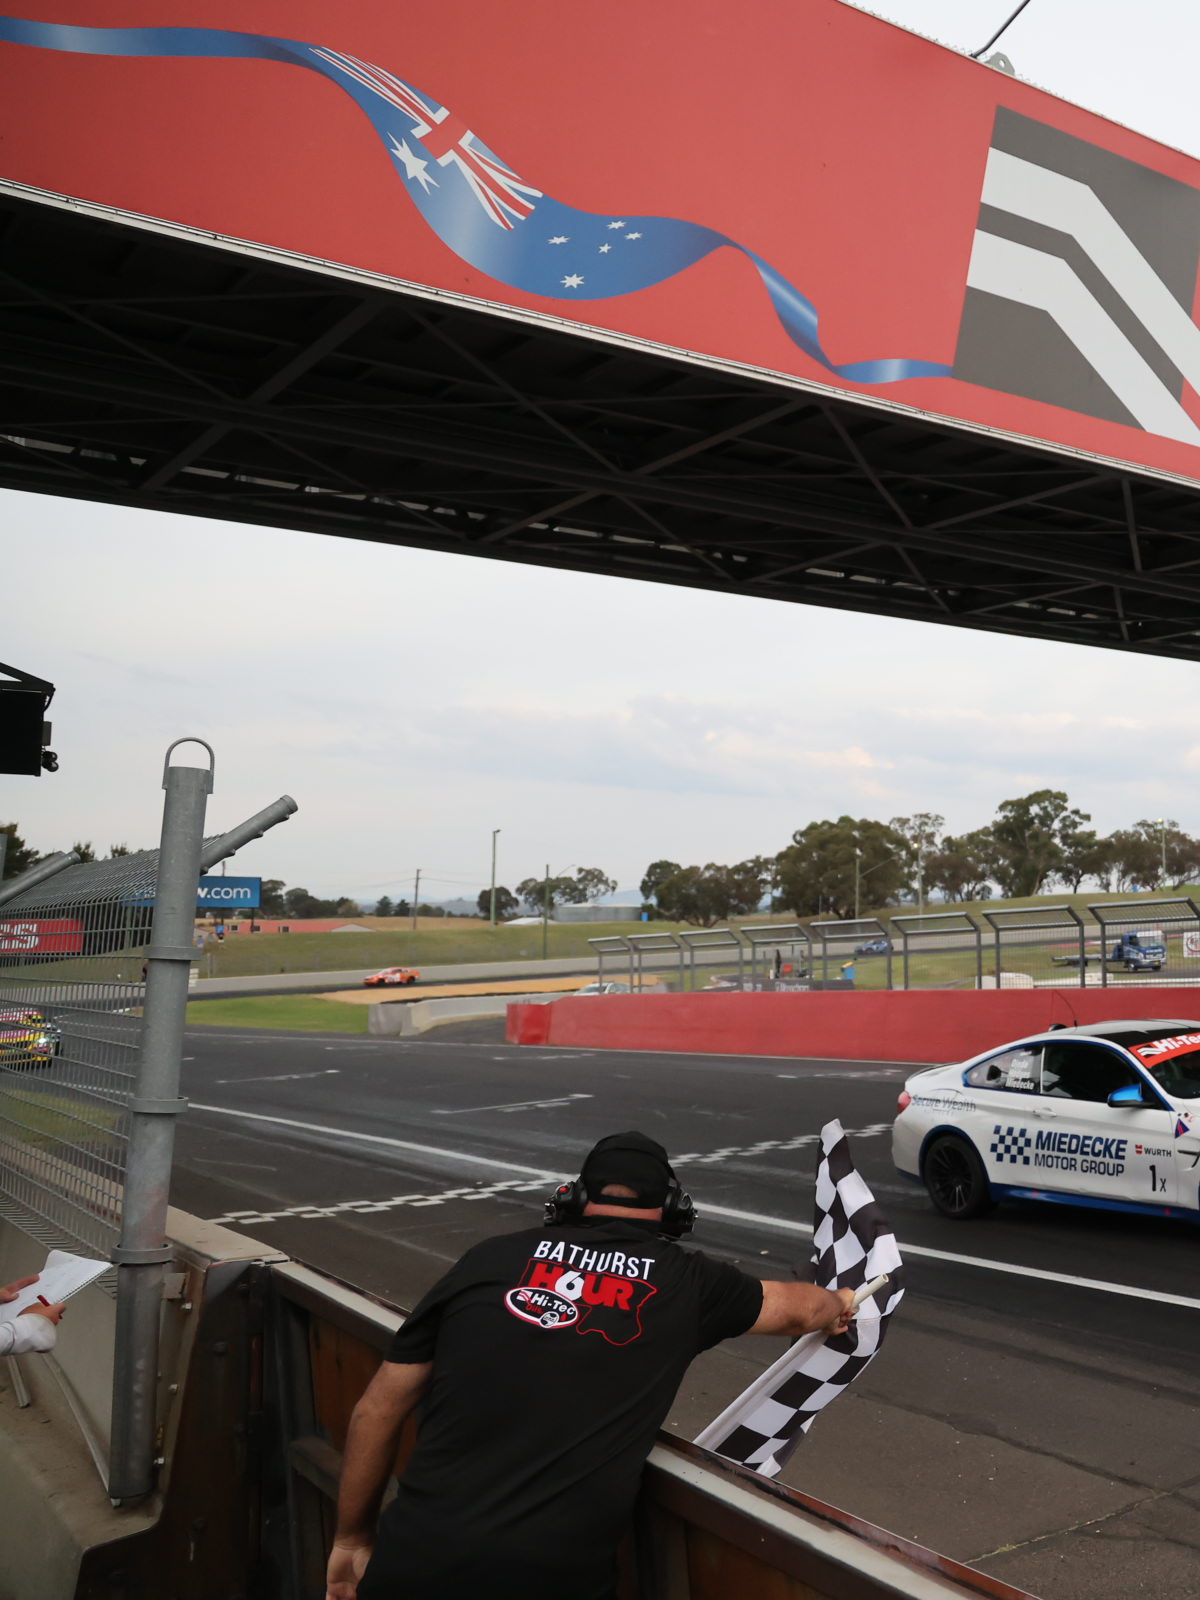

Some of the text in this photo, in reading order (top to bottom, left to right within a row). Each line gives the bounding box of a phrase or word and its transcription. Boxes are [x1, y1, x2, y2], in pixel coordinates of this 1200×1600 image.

[1035, 1130, 1128, 1160] MIEDECKE
[1034, 1153, 1125, 1177] MOTOR GROUP
[534, 1240, 655, 1280] BATHURST
[530, 1293, 576, 1315] Hi-Tec
